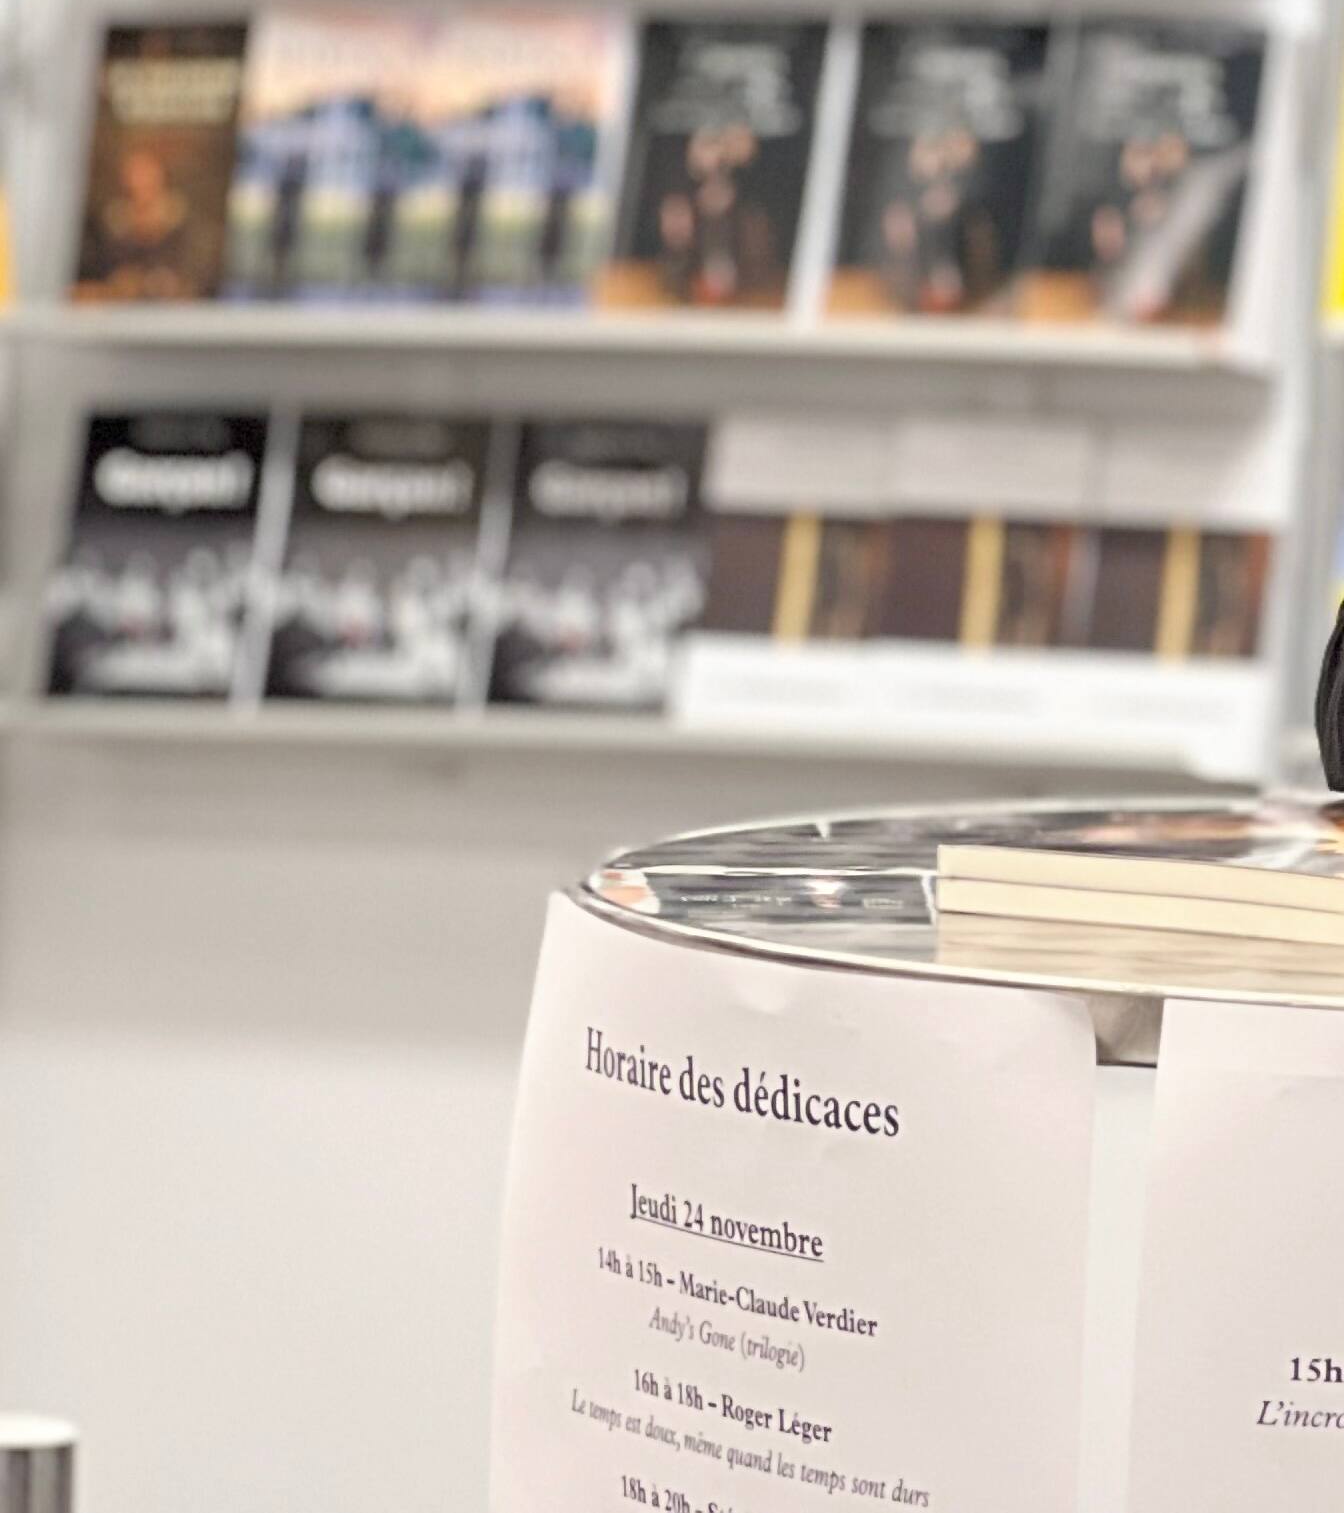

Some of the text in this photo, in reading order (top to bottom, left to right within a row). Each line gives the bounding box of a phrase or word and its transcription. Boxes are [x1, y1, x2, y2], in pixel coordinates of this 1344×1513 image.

[585, 1026, 900, 1136] Horaire des dédicaces
[630, 1183, 824, 1257] Jeudi 24 novembre
[598, 1247, 621, 1275] 14h
[625, 1256, 634, 1280] à
[637, 1261, 662, 1288] 15h
[679, 1270, 800, 1323] Marie-Claude
[804, 1300, 878, 1338] Verdier
[699, 1322, 736, 1353] Gone
[740, 1331, 805, 1372] (trilogie)
[1289, 1356, 1343, 1384] 15h
[634, 1368, 659, 1398] 16h
[663, 1376, 672, 1401] à
[677, 1382, 703, 1410] 18h
[721, 1394, 772, 1430] Roger
[778, 1406, 832, 1444] Léger
[571, 1388, 930, 1508] Le temps est doux, même quand les temps sont durs
[621, 1475, 647, 1504] 18h
[652, 1483, 660, 1508] à
[664, 1489, 690, 1513] 20h
